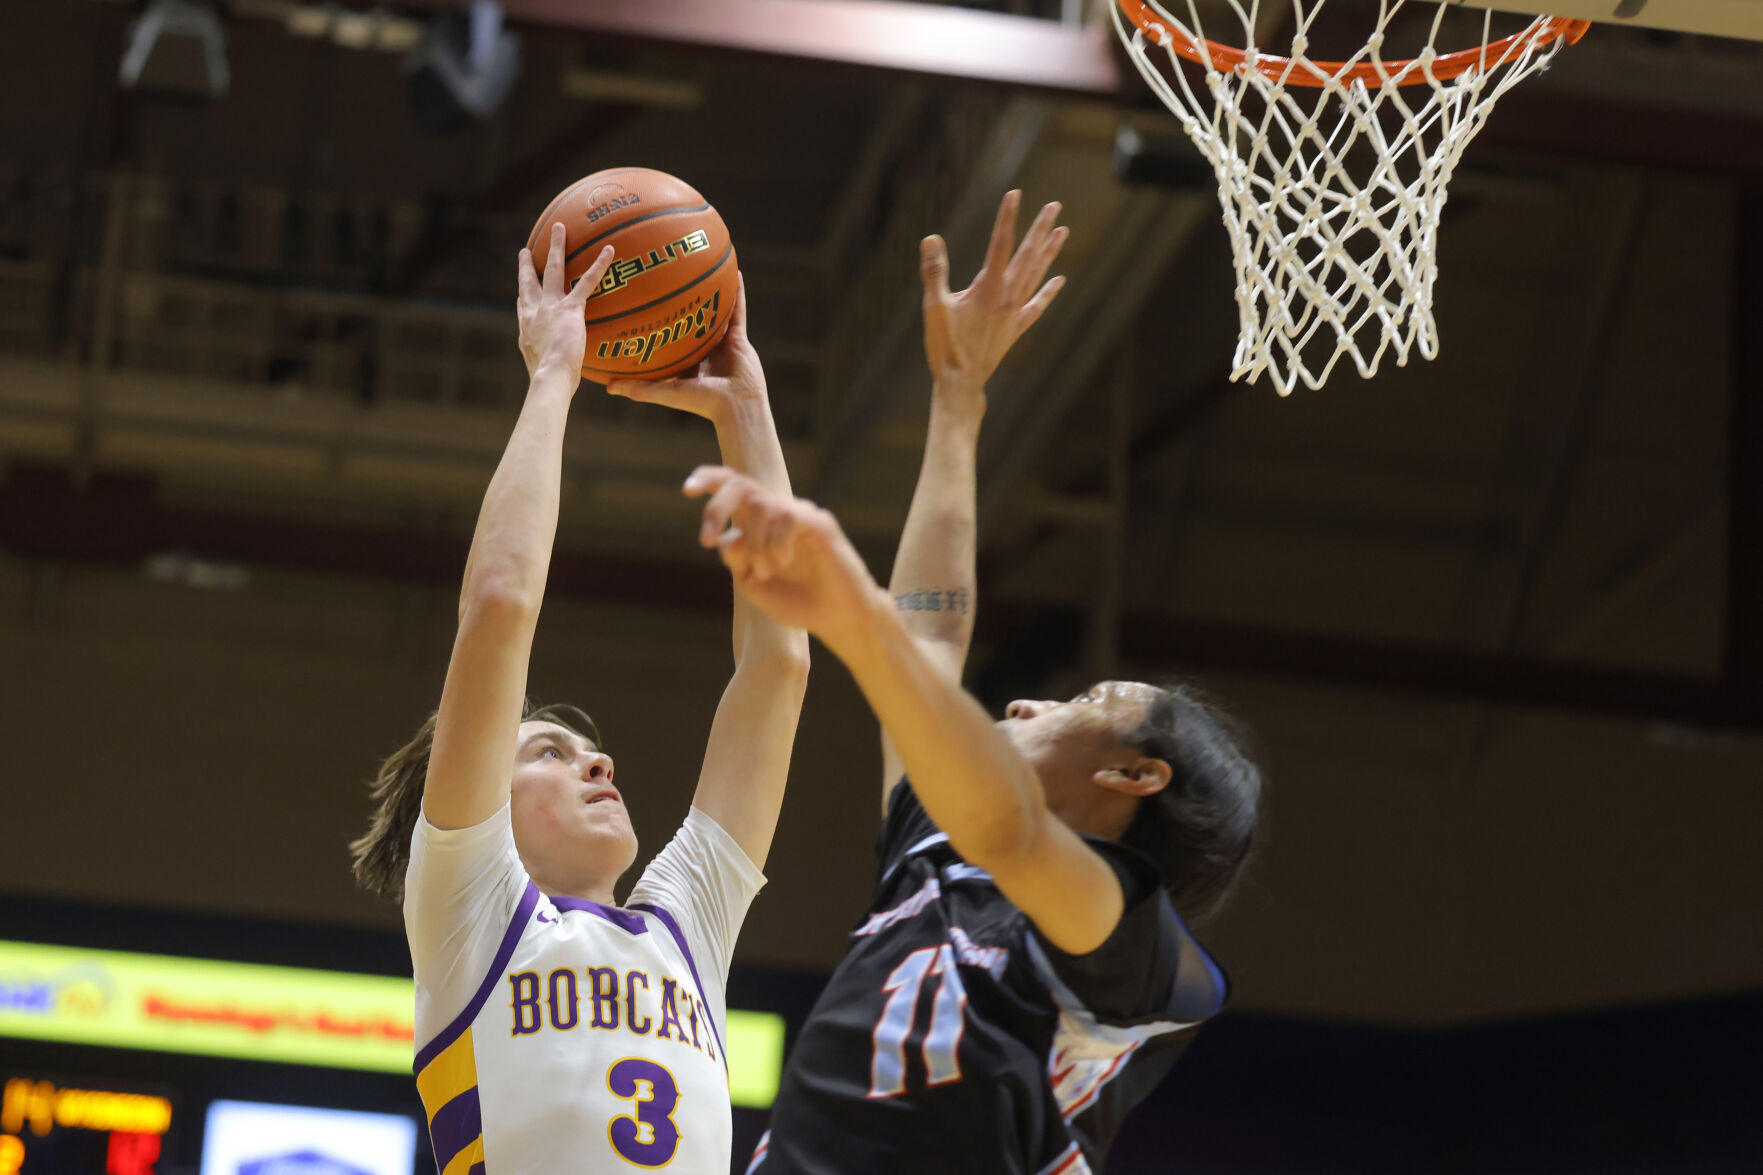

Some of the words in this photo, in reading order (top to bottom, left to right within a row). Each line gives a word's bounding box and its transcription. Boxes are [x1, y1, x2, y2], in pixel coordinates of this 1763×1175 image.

[587, 195, 630, 223] NFHS
[597, 288, 720, 364] Baden
[508, 965, 716, 1063] BOBCATS
[866, 943, 967, 1099] 11
[606, 1056, 683, 1170] 3
